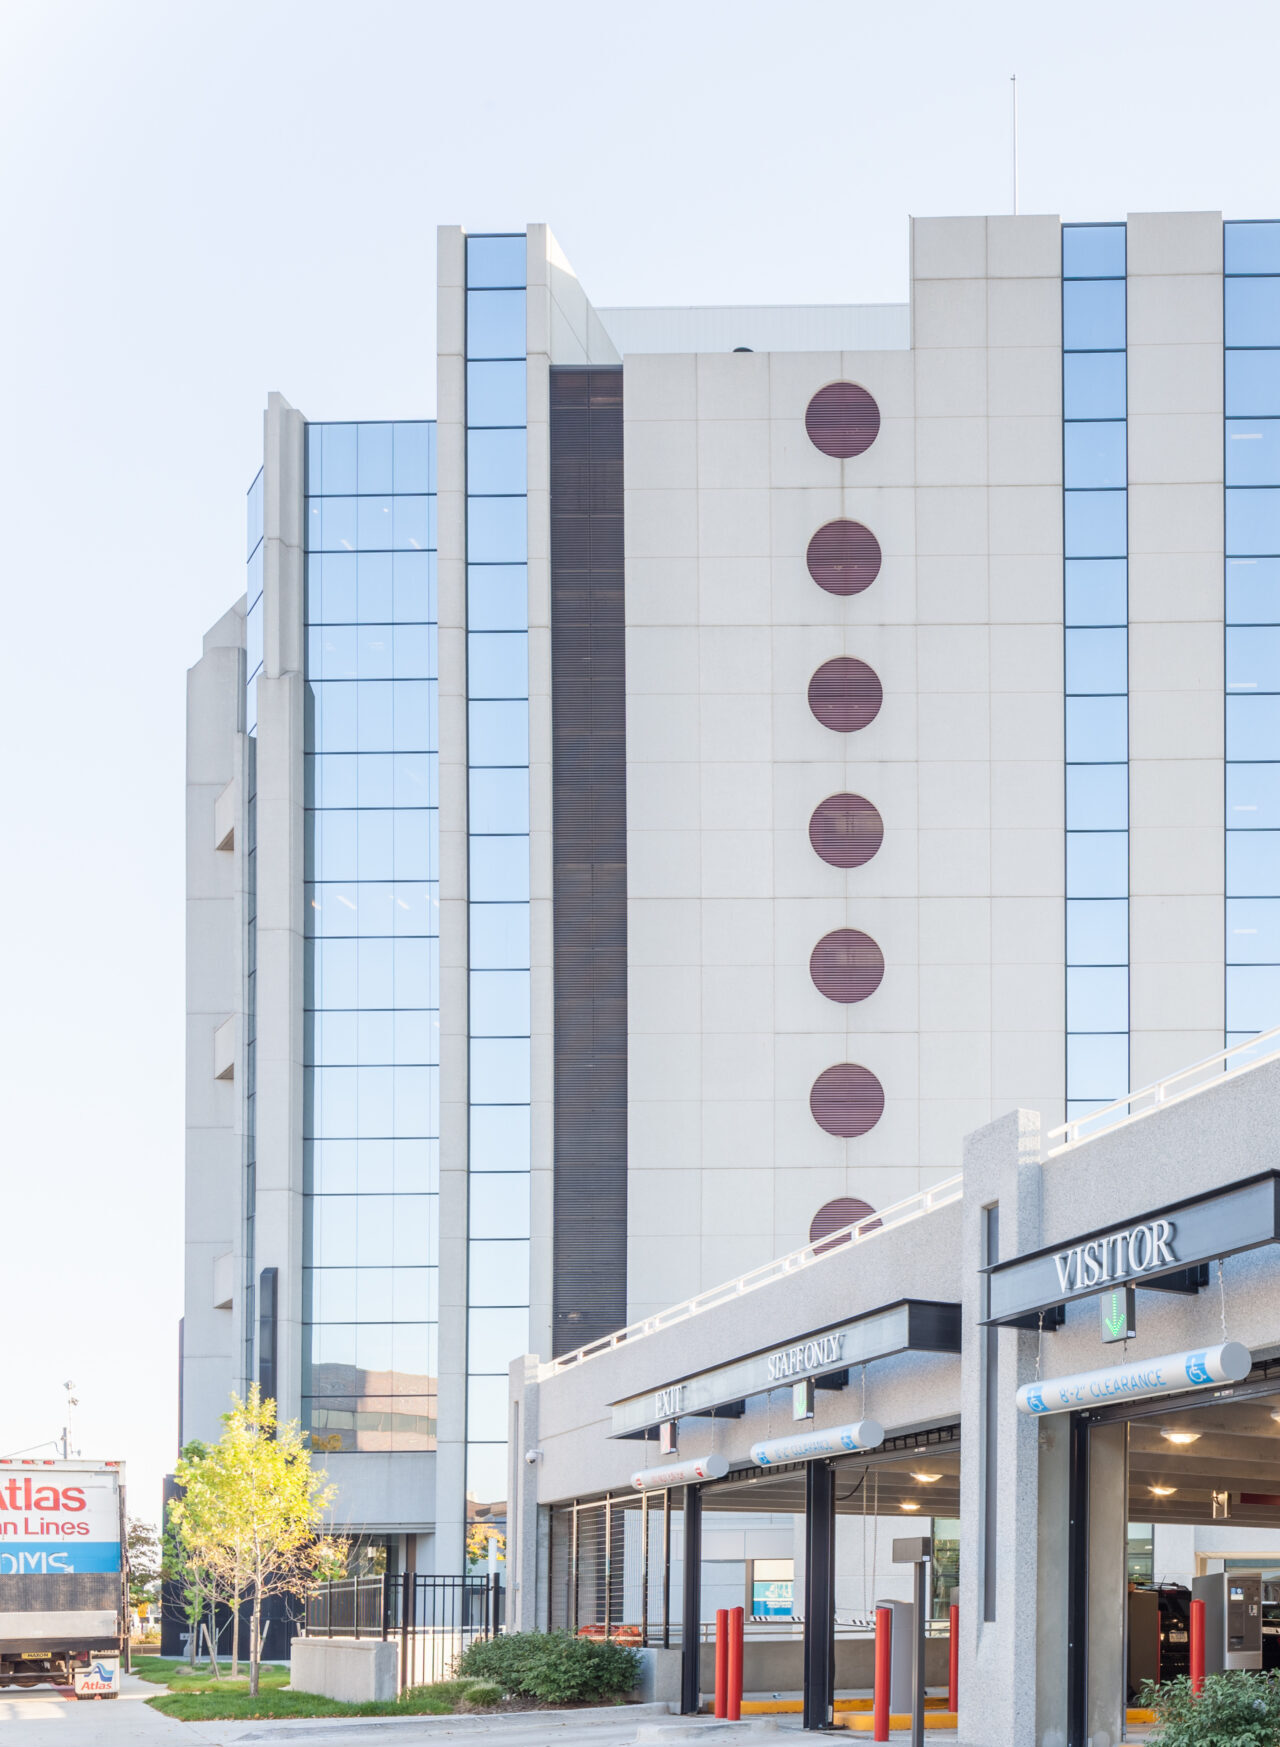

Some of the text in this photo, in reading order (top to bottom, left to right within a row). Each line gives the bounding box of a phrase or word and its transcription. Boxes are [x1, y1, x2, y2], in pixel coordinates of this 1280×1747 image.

[1052, 1219, 1175, 1294] VISITOR
[767, 1333, 841, 1381] STAFF ONLY
[1089, 1367, 1168, 1398] CLEARANCE
[655, 1385, 682, 1419] EXIT
[0, 1477, 87, 1513] tlas
[24, 1516, 91, 1536] Lines
[81, 1681, 112, 1691] Atlas
